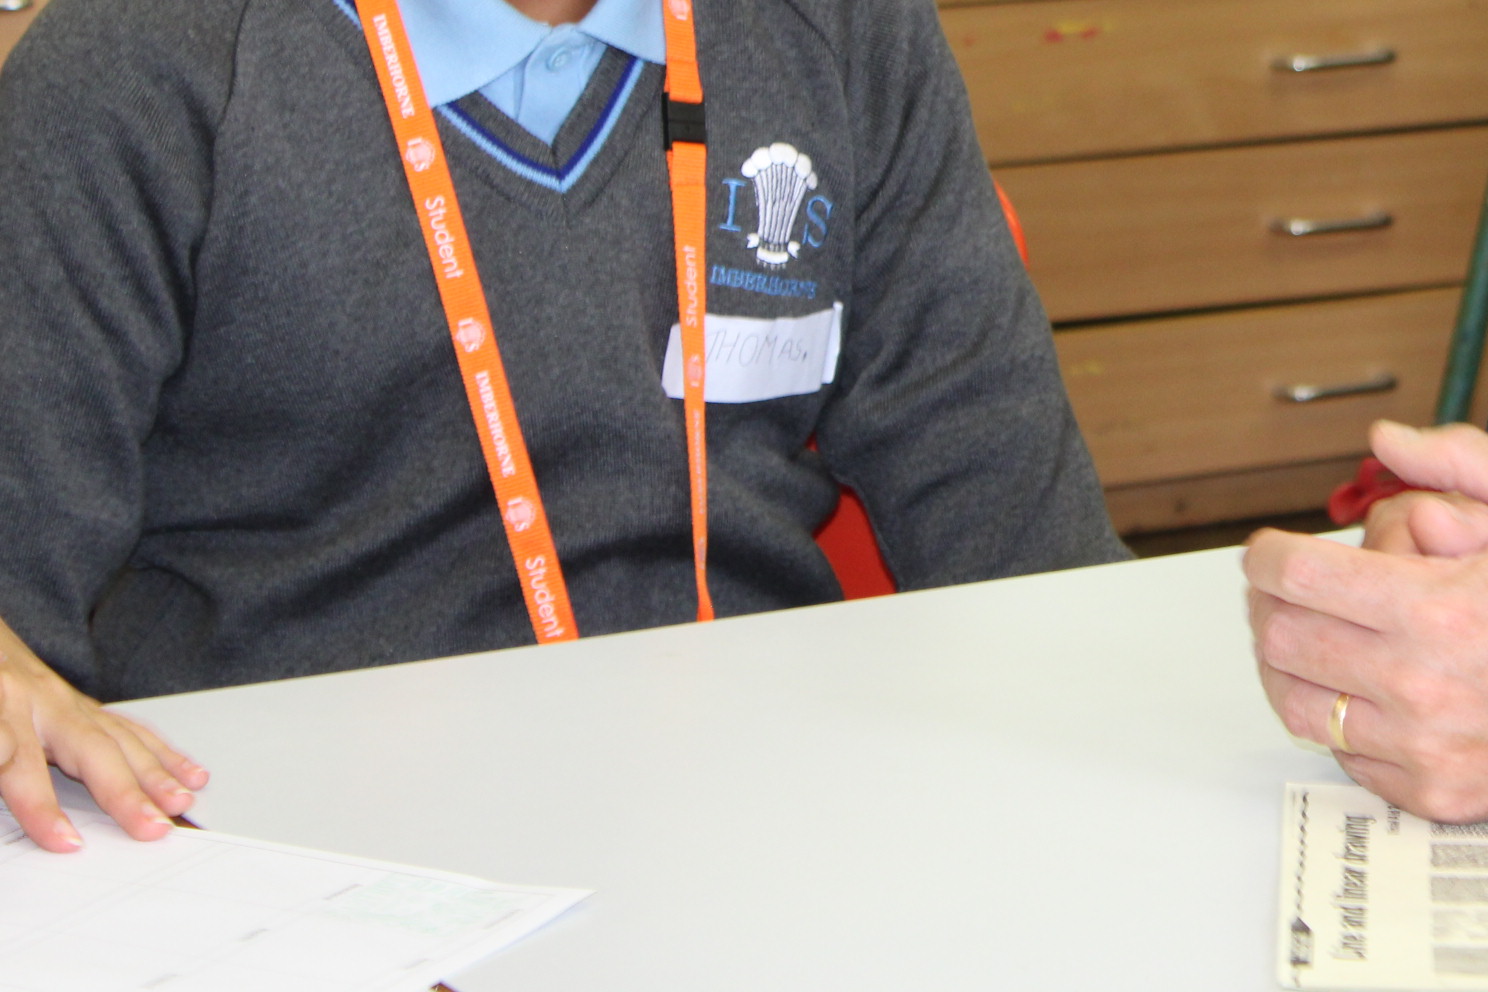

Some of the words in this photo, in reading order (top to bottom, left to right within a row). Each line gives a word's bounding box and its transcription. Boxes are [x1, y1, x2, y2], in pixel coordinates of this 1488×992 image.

[373, 13, 415, 119] IMBERHORNE
[425, 195, 464, 279] Student
[719, 177, 747, 232] I
[802, 194, 834, 248] S
[681, 245, 698, 328] Student
[475, 370, 516, 478] IMBERHORNE
[525, 555, 564, 639] Student
[1336, 814, 1377, 865] drawing
[1335, 866, 1367, 904] linear
[1336, 905, 1367, 930] and
[1333, 933, 1367, 961] Line
